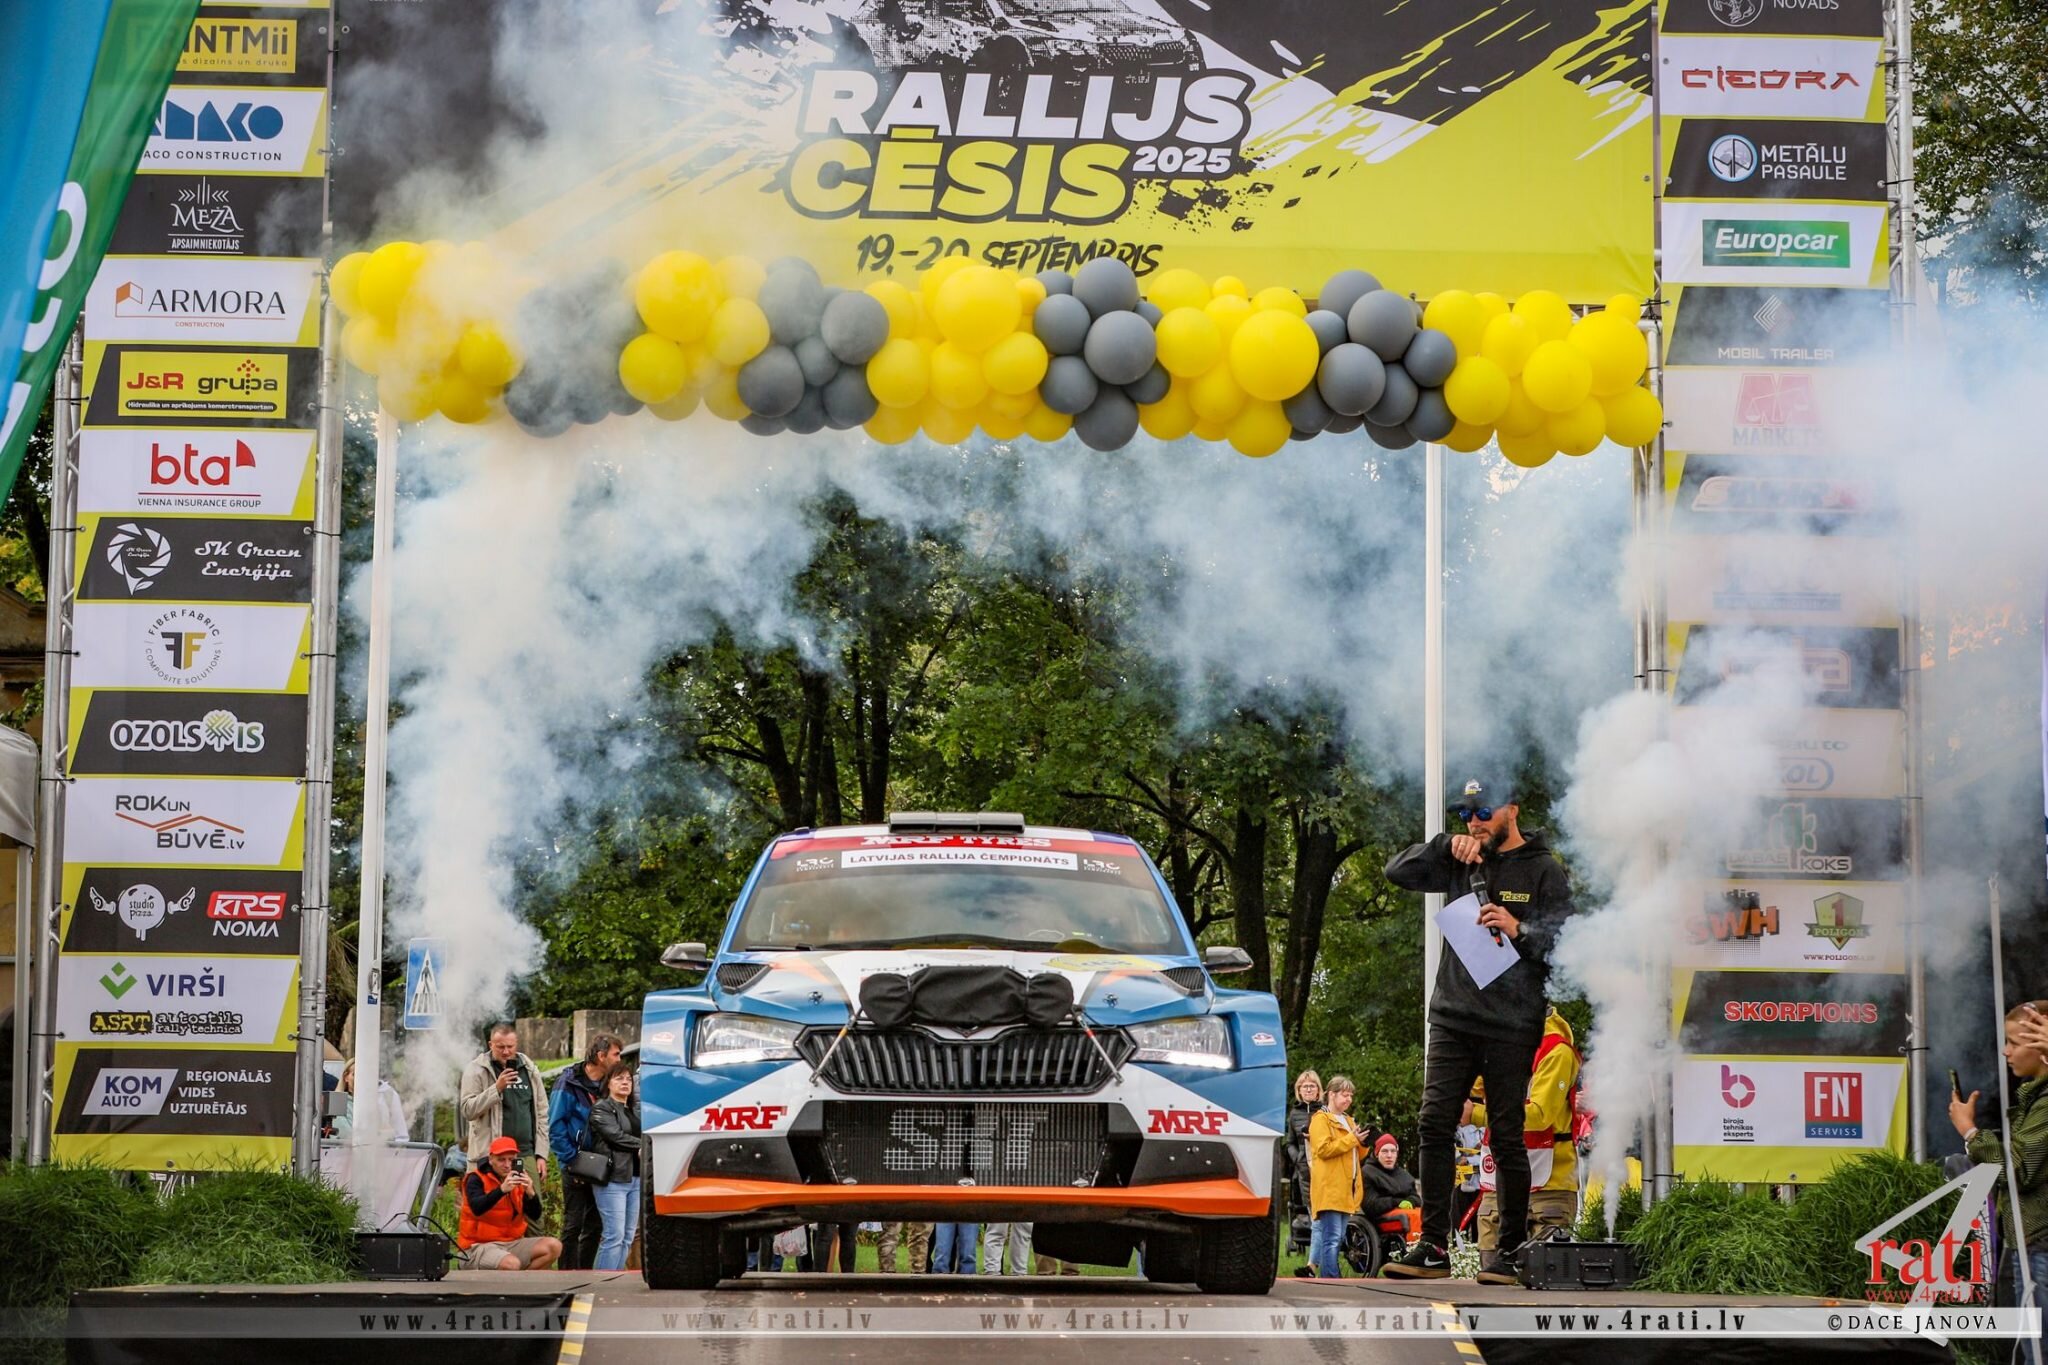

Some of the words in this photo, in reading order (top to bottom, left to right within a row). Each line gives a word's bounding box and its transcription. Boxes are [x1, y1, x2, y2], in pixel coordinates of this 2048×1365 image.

[803, 68, 1253, 144] RALLIJS
[143, 150, 171, 160] ACO
[175, 150, 283, 162] CONSTRUCTION
[1760, 142, 1847, 165] METĀLU
[788, 128, 1135, 221] CĒSIS
[1132, 145, 1233, 175] 2025
[1760, 164, 1847, 181] PASAULE
[1714, 227, 1839, 257] Europcar
[148, 288, 286, 315] ARMORA
[174, 320, 225, 329] CONSTRUCTION
[1717, 346, 1765, 360] MOBIL
[1770, 348, 1835, 361] TRAILER
[126, 372, 184, 391] J&R
[150, 442, 231, 486] bta
[137, 497, 172, 507] VIENNA
[174, 498, 228, 508] INSURANCE
[229, 499, 262, 509] GROUP
[237, 540, 302, 558] Green
[148, 610, 178, 637] FIBER
[181, 608, 220, 638] FABRIC
[860, 835, 954, 846] MRF
[959, 835, 1052, 847] TYRES
[849, 852, 915, 864] LATVIJAS
[919, 852, 976, 861] RALLIJA
[1800, 858, 1849, 872] KOKS
[212, 920, 279, 938] NOMA
[145, 966, 226, 998] VIRŠI
[156, 1011, 242, 1025] autostils
[1724, 1000, 1878, 1024] SKORPIONS
[91, 1013, 152, 1032] ASRT
[104, 1075, 162, 1095] KOM
[178, 1086, 215, 1099] VIDES
[101, 1095, 142, 1108] AUTO
[169, 1100, 248, 1116] UZTURĒTĀJS
[699, 1105, 788, 1131] MRF
[1147, 1109, 1229, 1136] MRF
[1722, 1117, 1745, 1126] biroja
[1723, 1130, 1755, 1139] eksperts
[1810, 1127, 1858, 1137] SERVISS
